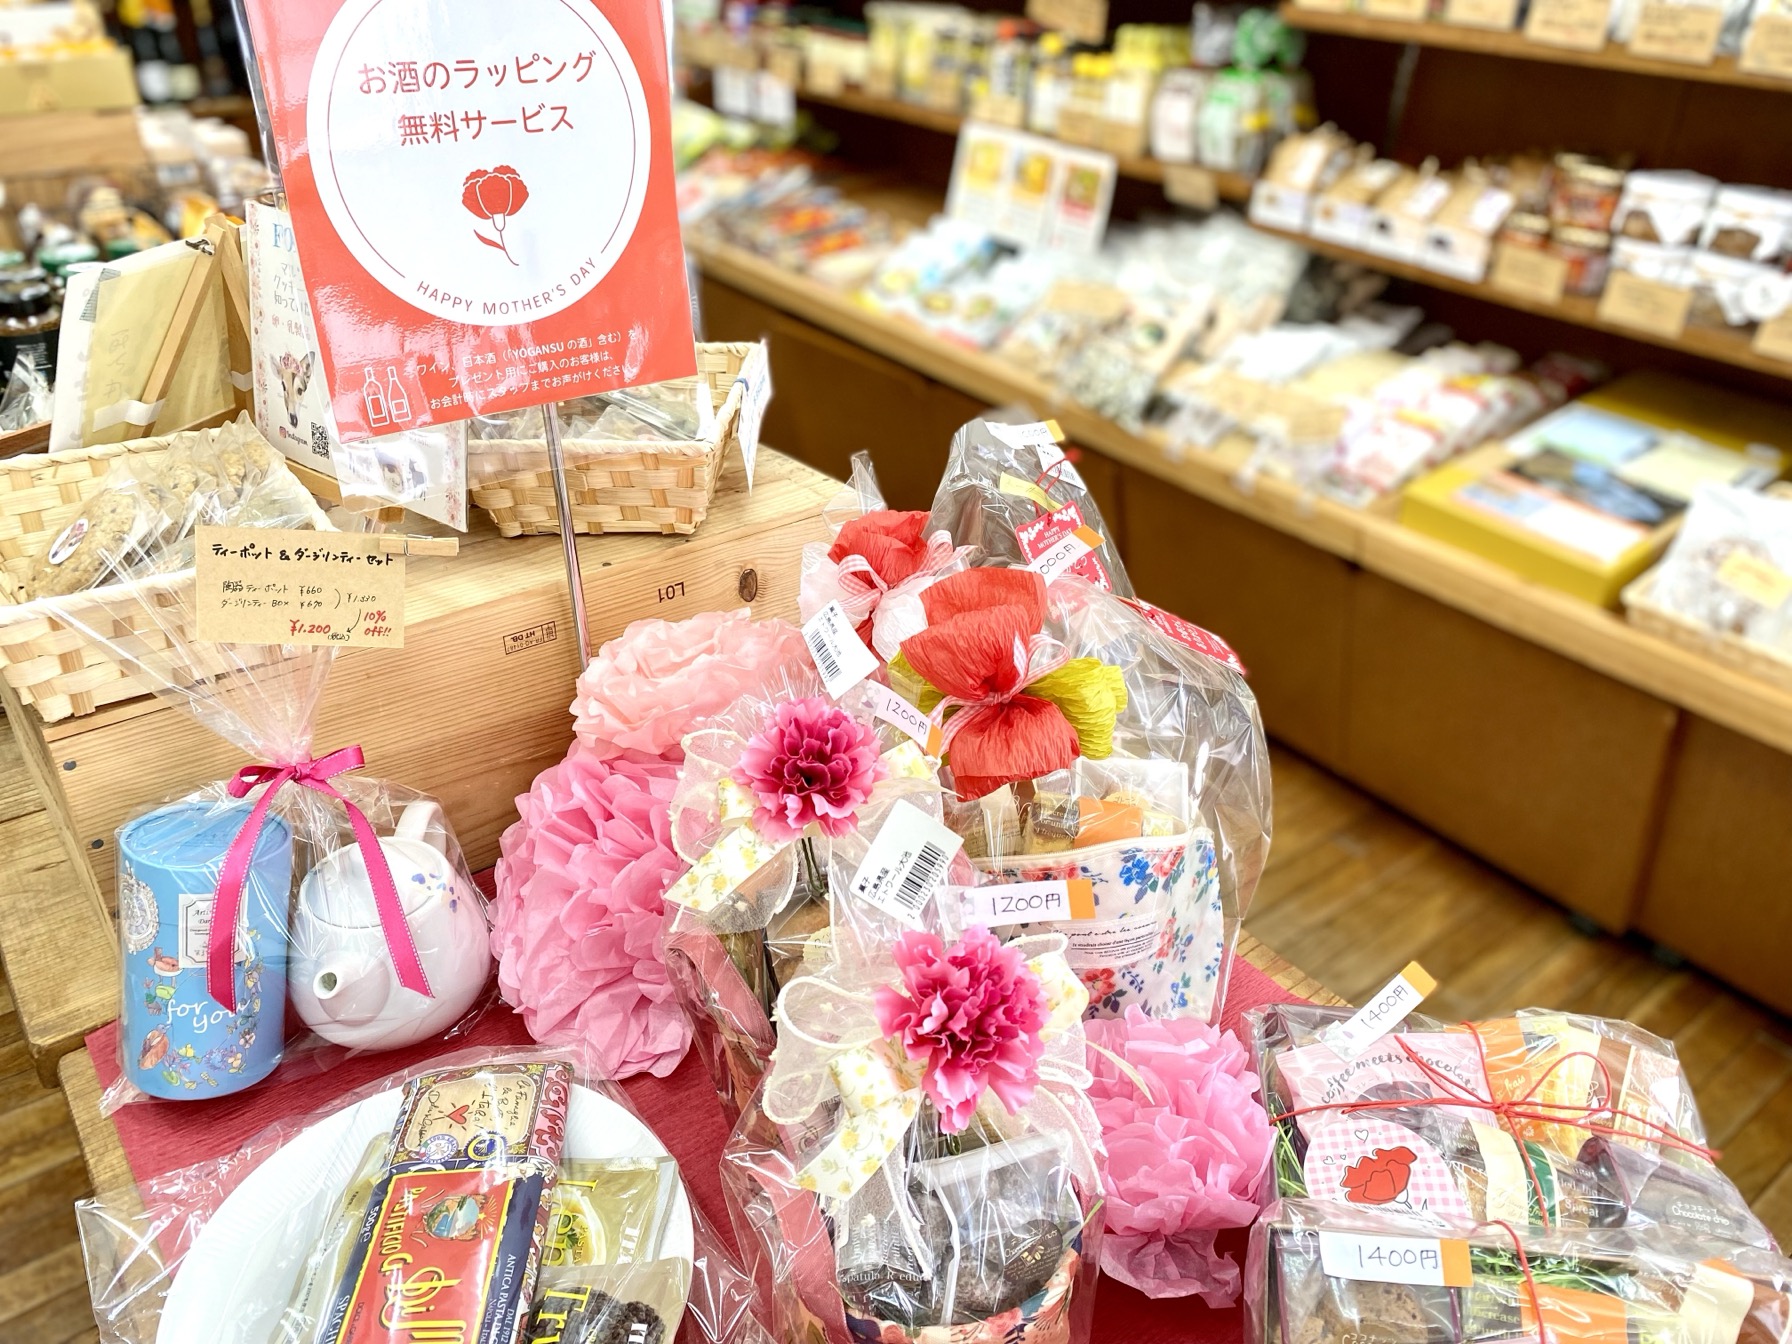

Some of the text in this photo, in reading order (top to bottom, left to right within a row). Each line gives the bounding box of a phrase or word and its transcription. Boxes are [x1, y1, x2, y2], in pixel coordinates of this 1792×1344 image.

[358, 50, 597, 95] お酒のラッピング
[398, 103, 574, 146] 無料サービス
[416, 257, 597, 315] HAPPY MOTHER'S DAY
[212, 543, 272, 560] ティーポット
[279, 549, 290, 561] &
[657, 581, 686, 603] L01
[363, 610, 387, 624] 10%
[885, 697, 928, 735] 1200円
[992, 893, 1061, 916] 1200円
[166, 998, 208, 1024] for
[1360, 984, 1409, 1030] 1400円
[1358, 1244, 1439, 1270] 1400円
[501, 1253, 517, 1295] ANTICA
